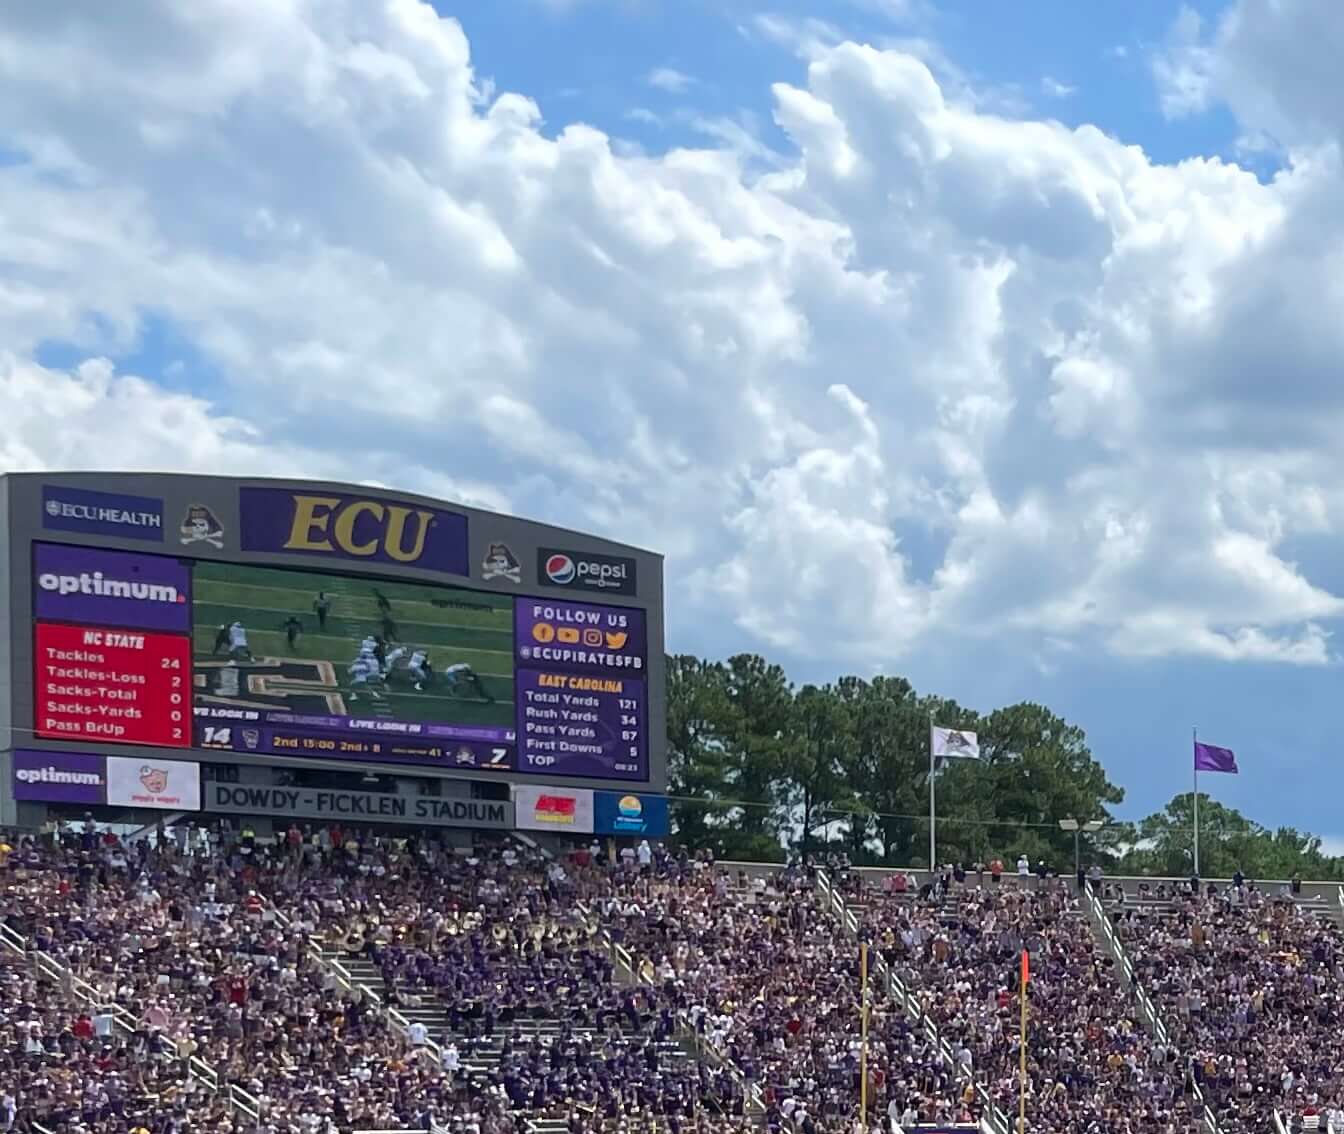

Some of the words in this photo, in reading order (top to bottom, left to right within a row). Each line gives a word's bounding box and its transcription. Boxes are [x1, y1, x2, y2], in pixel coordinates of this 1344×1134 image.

[99, 507, 161, 527] HEALTH
[284, 495, 433, 562] ECU
[577, 561, 627, 579] pepsi
[534, 606, 600, 624] FOLLOW
[608, 615, 627, 627] US
[83, 631, 103, 645] NC
[104, 634, 145, 649] STATE
[46, 647, 104, 663] Tackles
[161, 658, 180, 669] 24
[46, 665, 145, 684] Tackles-Loss
[172, 676, 181, 688] 2
[538, 673, 567, 687] EAST
[569, 678, 623, 693] CAROLINA
[47, 683, 137, 700] Sacks-Total
[171, 694, 181, 704] 0
[525, 691, 559, 703] Total
[562, 694, 600, 707] Yards
[47, 701, 142, 718] Sacks-Yards
[618, 699, 637, 710] 121
[171, 711, 181, 721] 0
[526, 707, 558, 719] Rush
[561, 710, 598, 722] Yards
[46, 719, 81, 732] Pass
[172, 728, 182, 739] 2
[526, 722, 555, 734] Pass
[558, 725, 596, 738] Yards
[203, 727, 232, 744] 14
[273, 736, 298, 748] 2nd
[526, 739, 555, 750] First
[560, 741, 603, 754] Downs
[491, 748, 506, 764] 7
[527, 754, 555, 766] TOP
[415, 801, 505, 822] STADIUM
